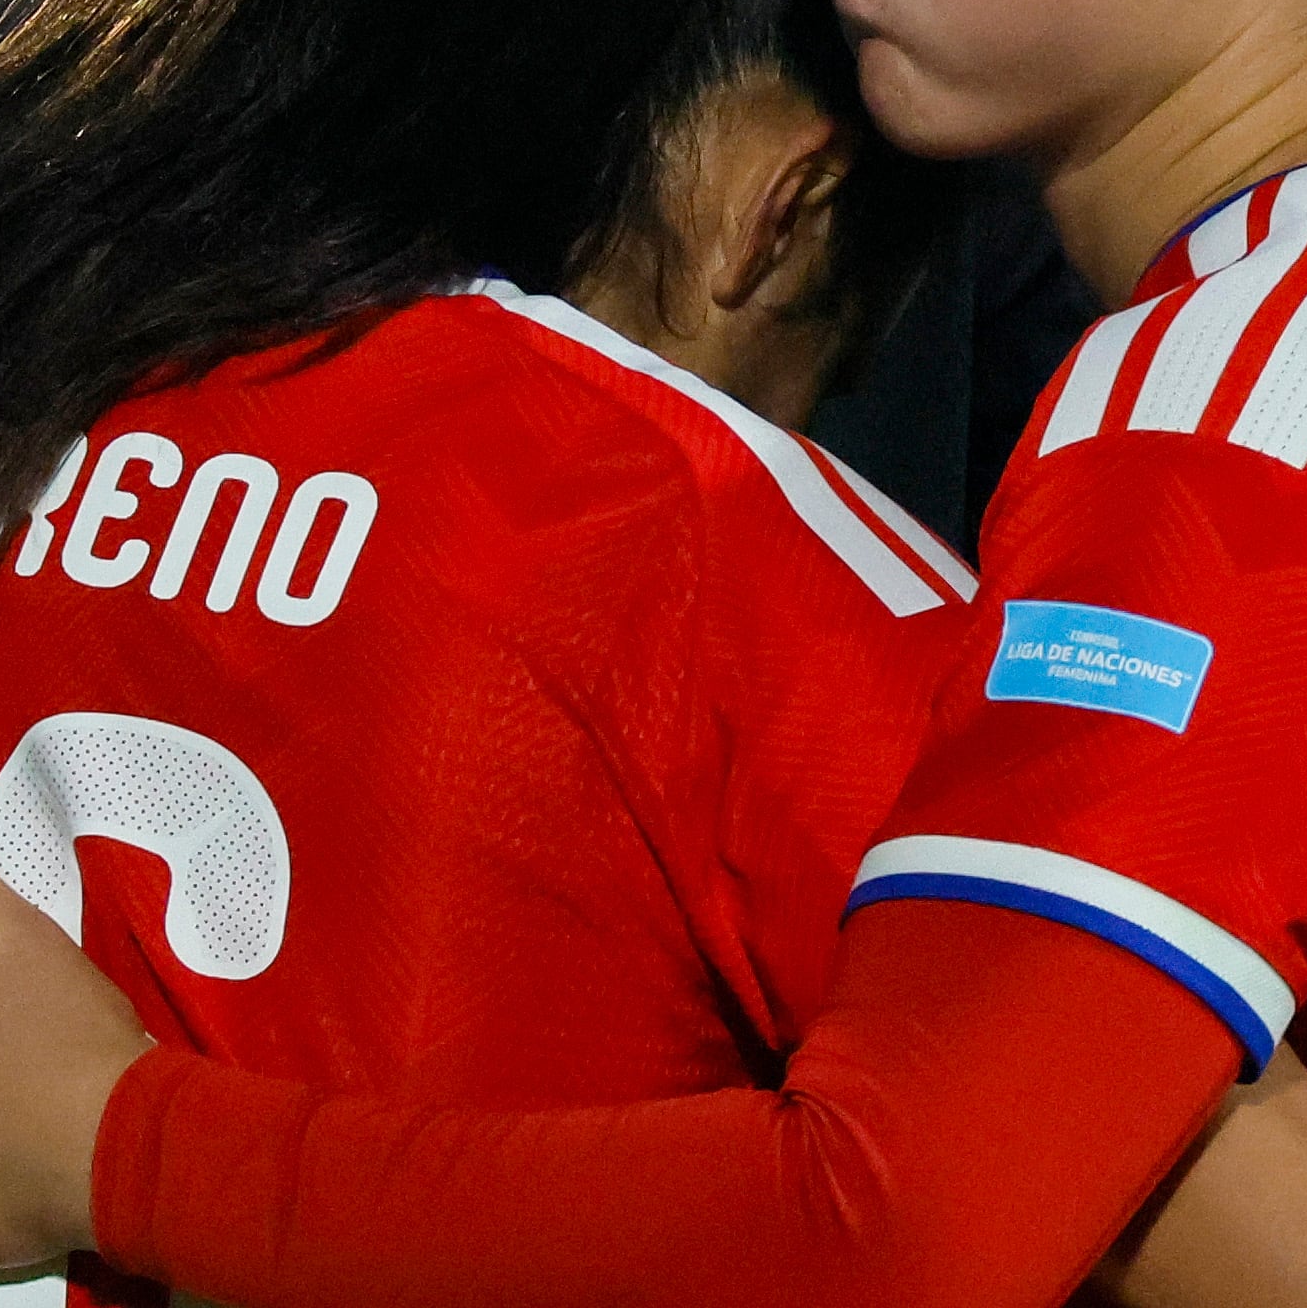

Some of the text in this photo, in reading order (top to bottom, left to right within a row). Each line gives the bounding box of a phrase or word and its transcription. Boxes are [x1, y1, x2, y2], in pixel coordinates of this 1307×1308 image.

[1007, 643, 1183, 688] LIGA DE NACIONES
